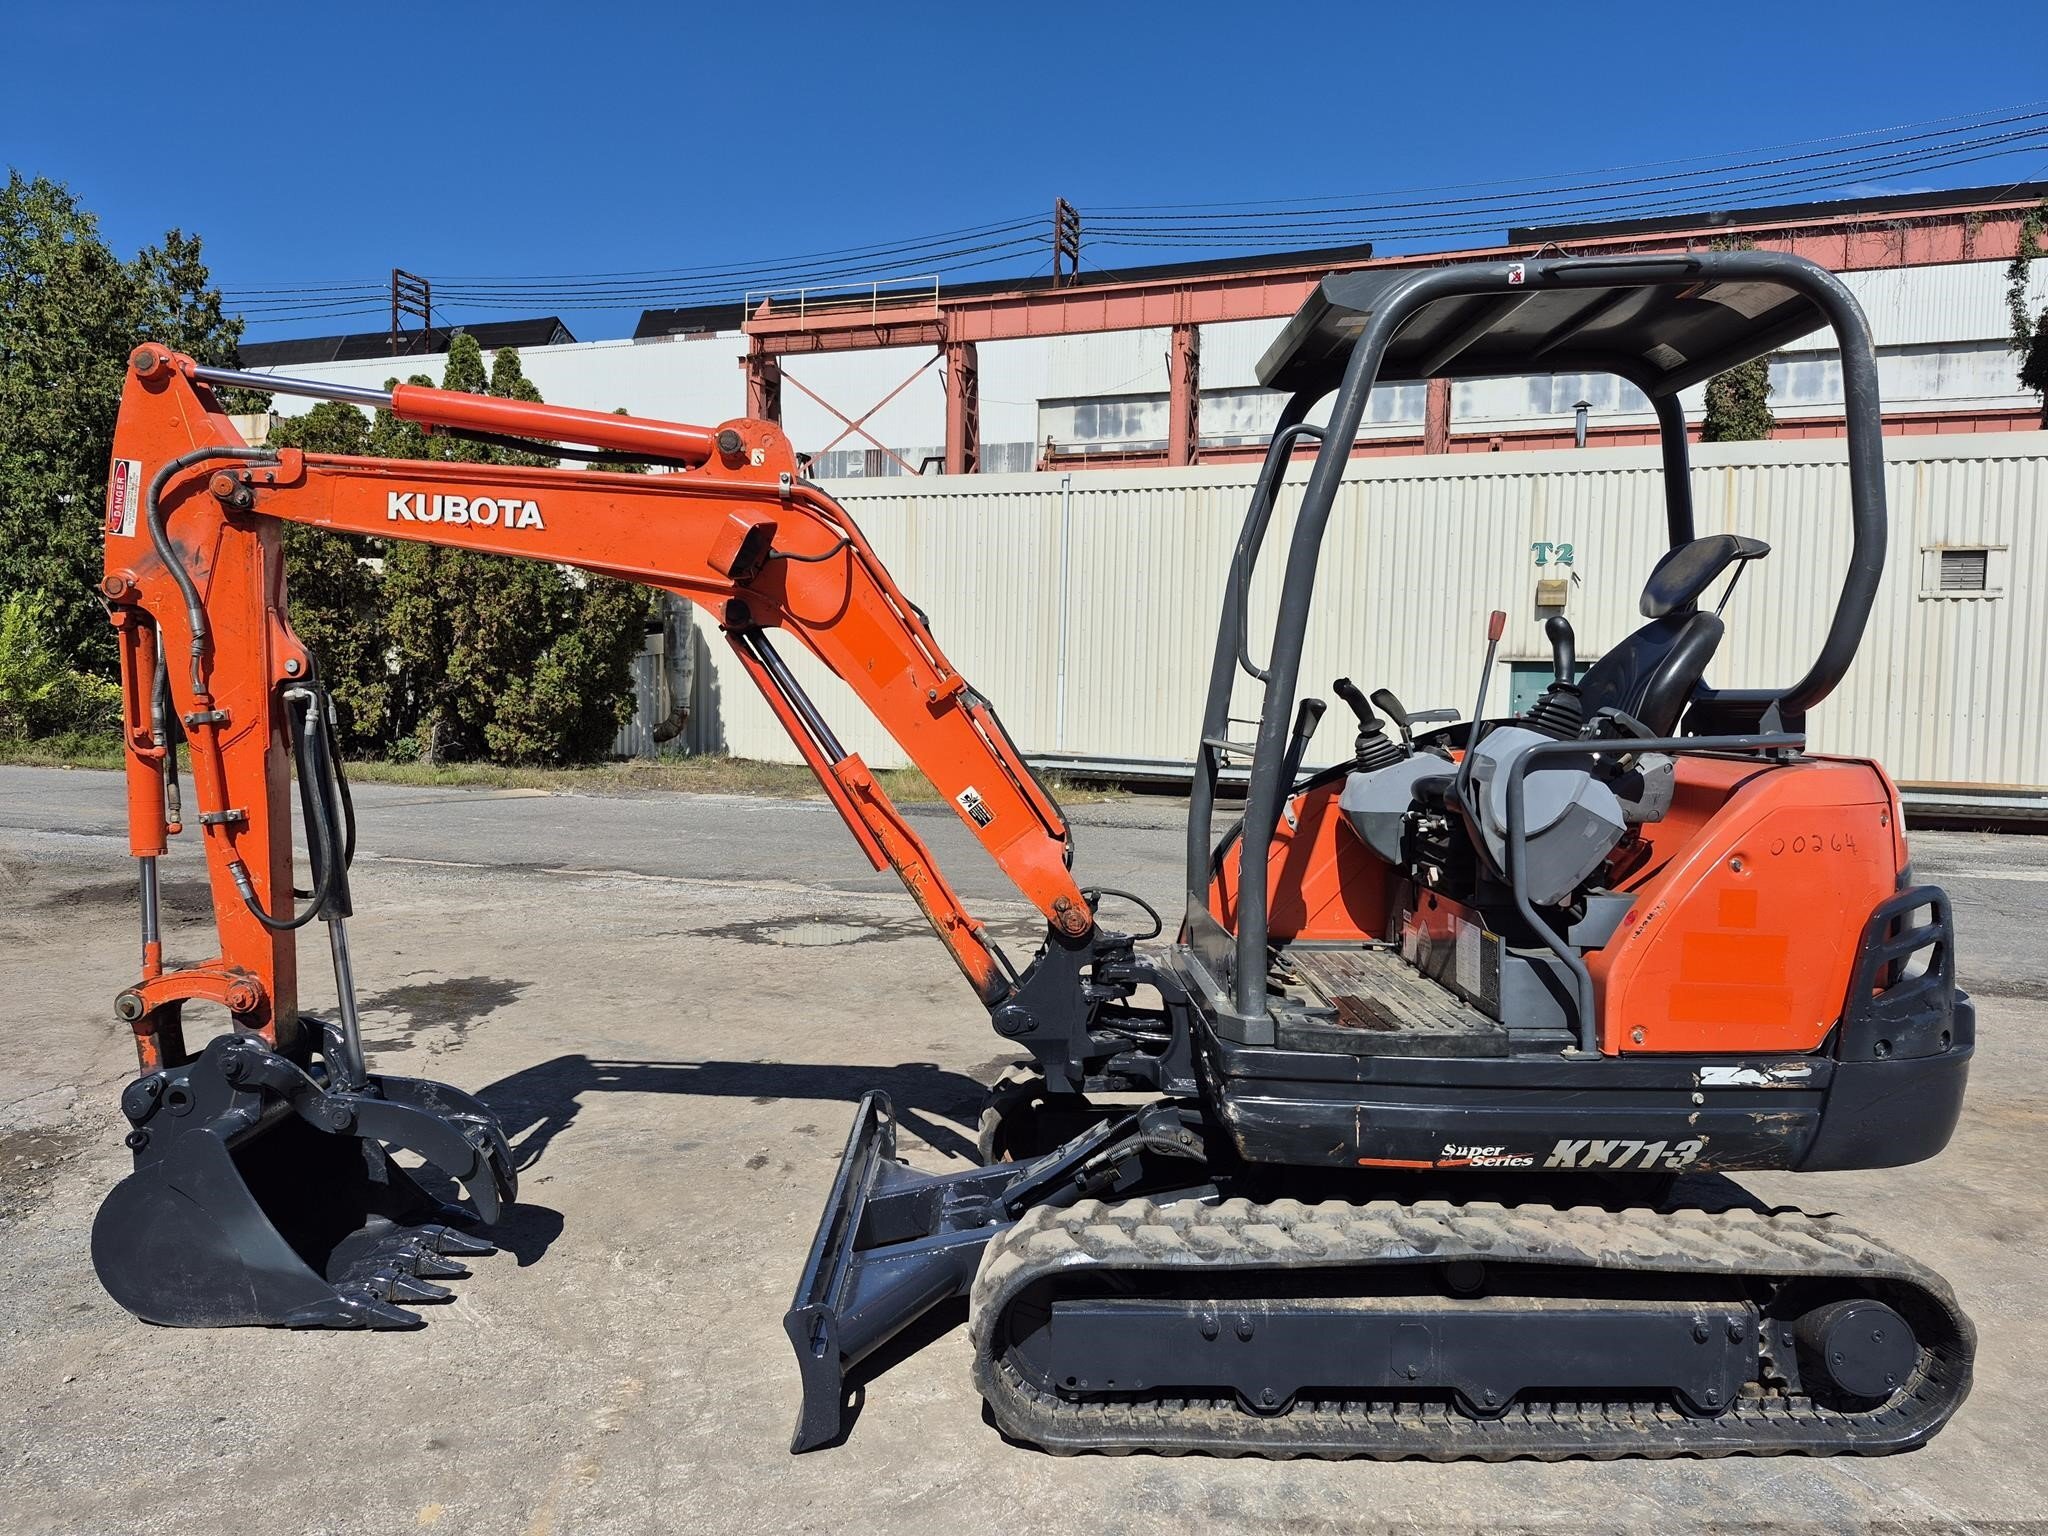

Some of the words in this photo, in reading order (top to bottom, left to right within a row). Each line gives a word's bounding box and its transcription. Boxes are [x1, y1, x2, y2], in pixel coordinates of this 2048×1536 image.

[113, 477, 125, 517] DANGER
[387, 491, 546, 529] KUBOTA
[1531, 542, 1574, 567] T2
[1770, 833, 1858, 856] 00264
[1441, 1143, 1506, 1160] Super
[1469, 1154, 1535, 1167] Series
[1543, 1139, 1704, 1170] KX71-3
